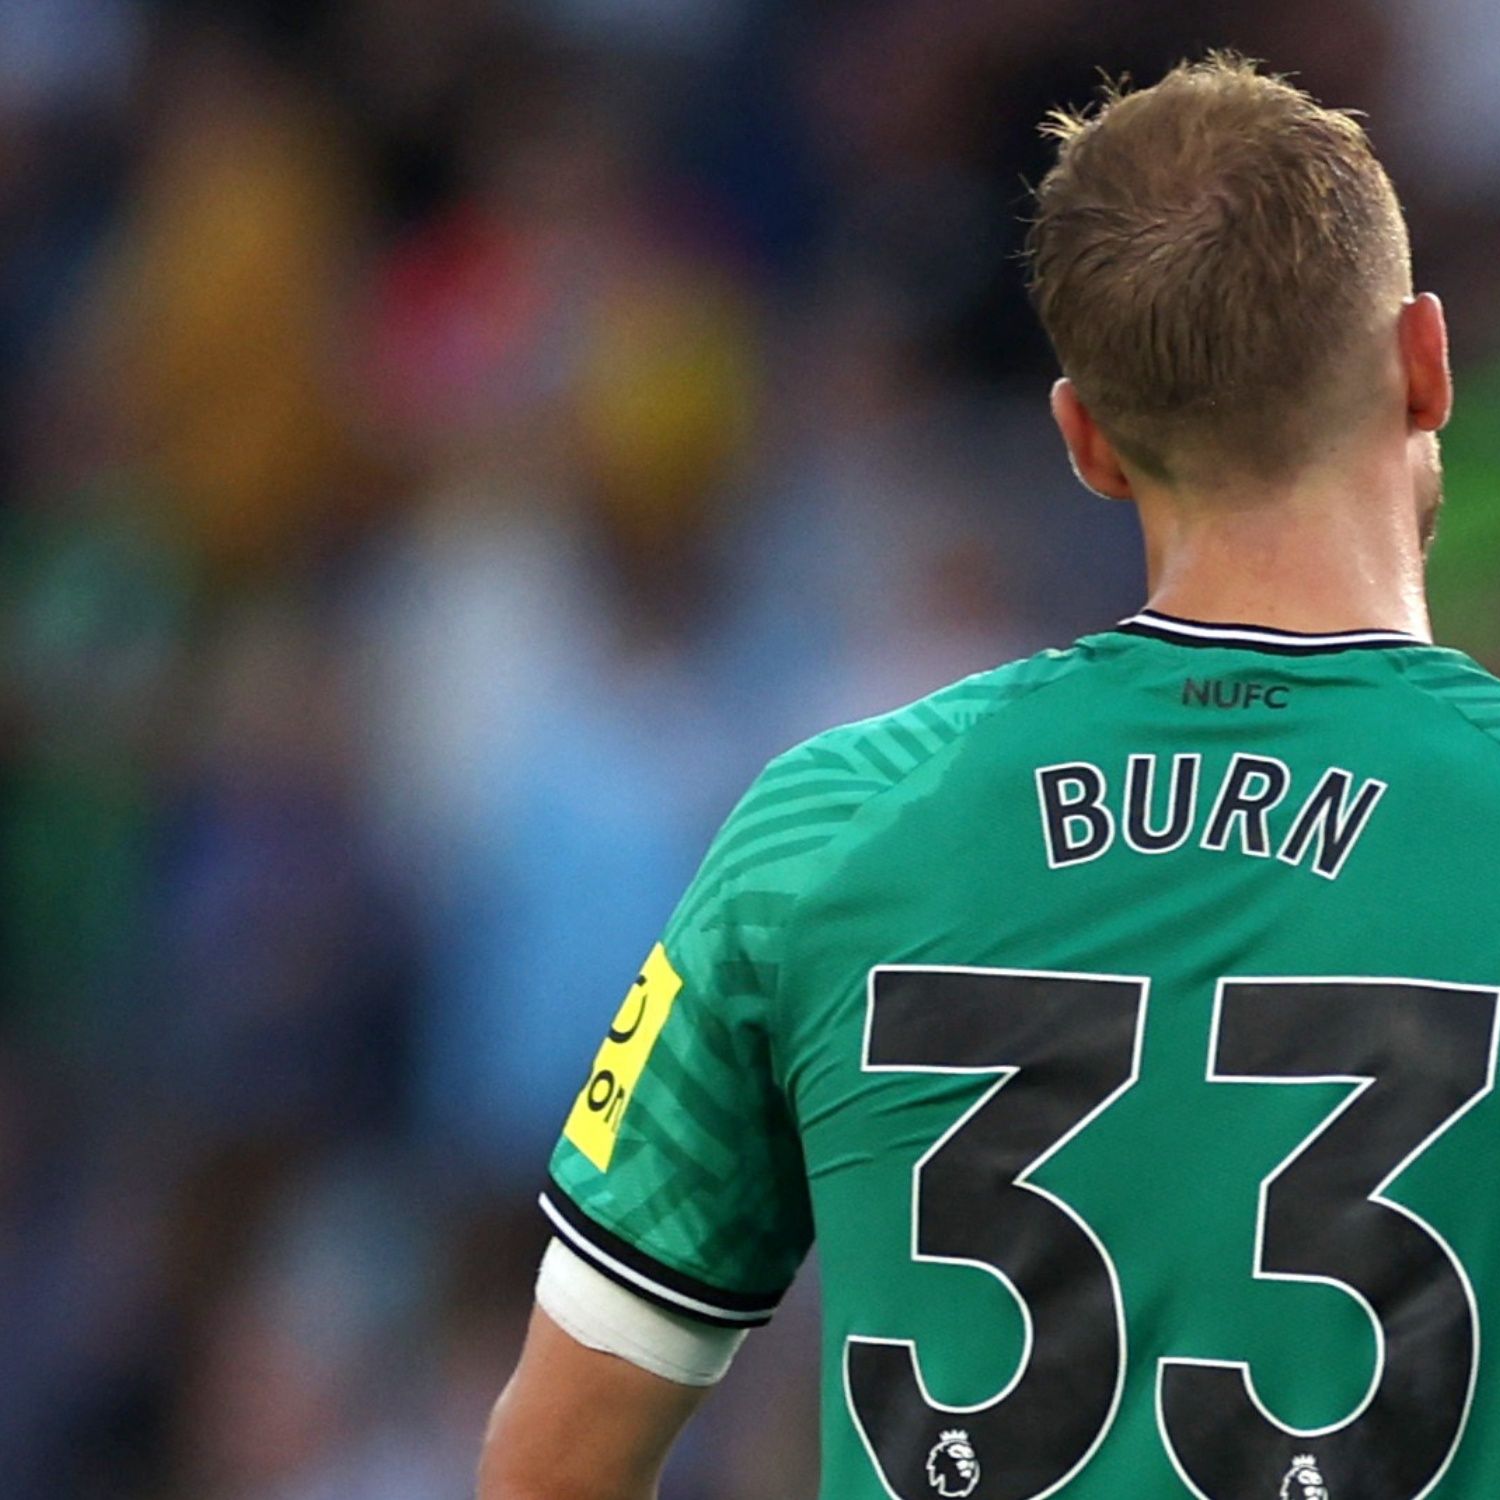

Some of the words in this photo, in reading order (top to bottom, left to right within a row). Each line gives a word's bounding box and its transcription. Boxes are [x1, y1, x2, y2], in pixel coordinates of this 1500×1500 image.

[1181, 677, 1290, 710] NUFC
[1034, 752, 1388, 880] BURN
[586, 1069, 625, 1133] on
